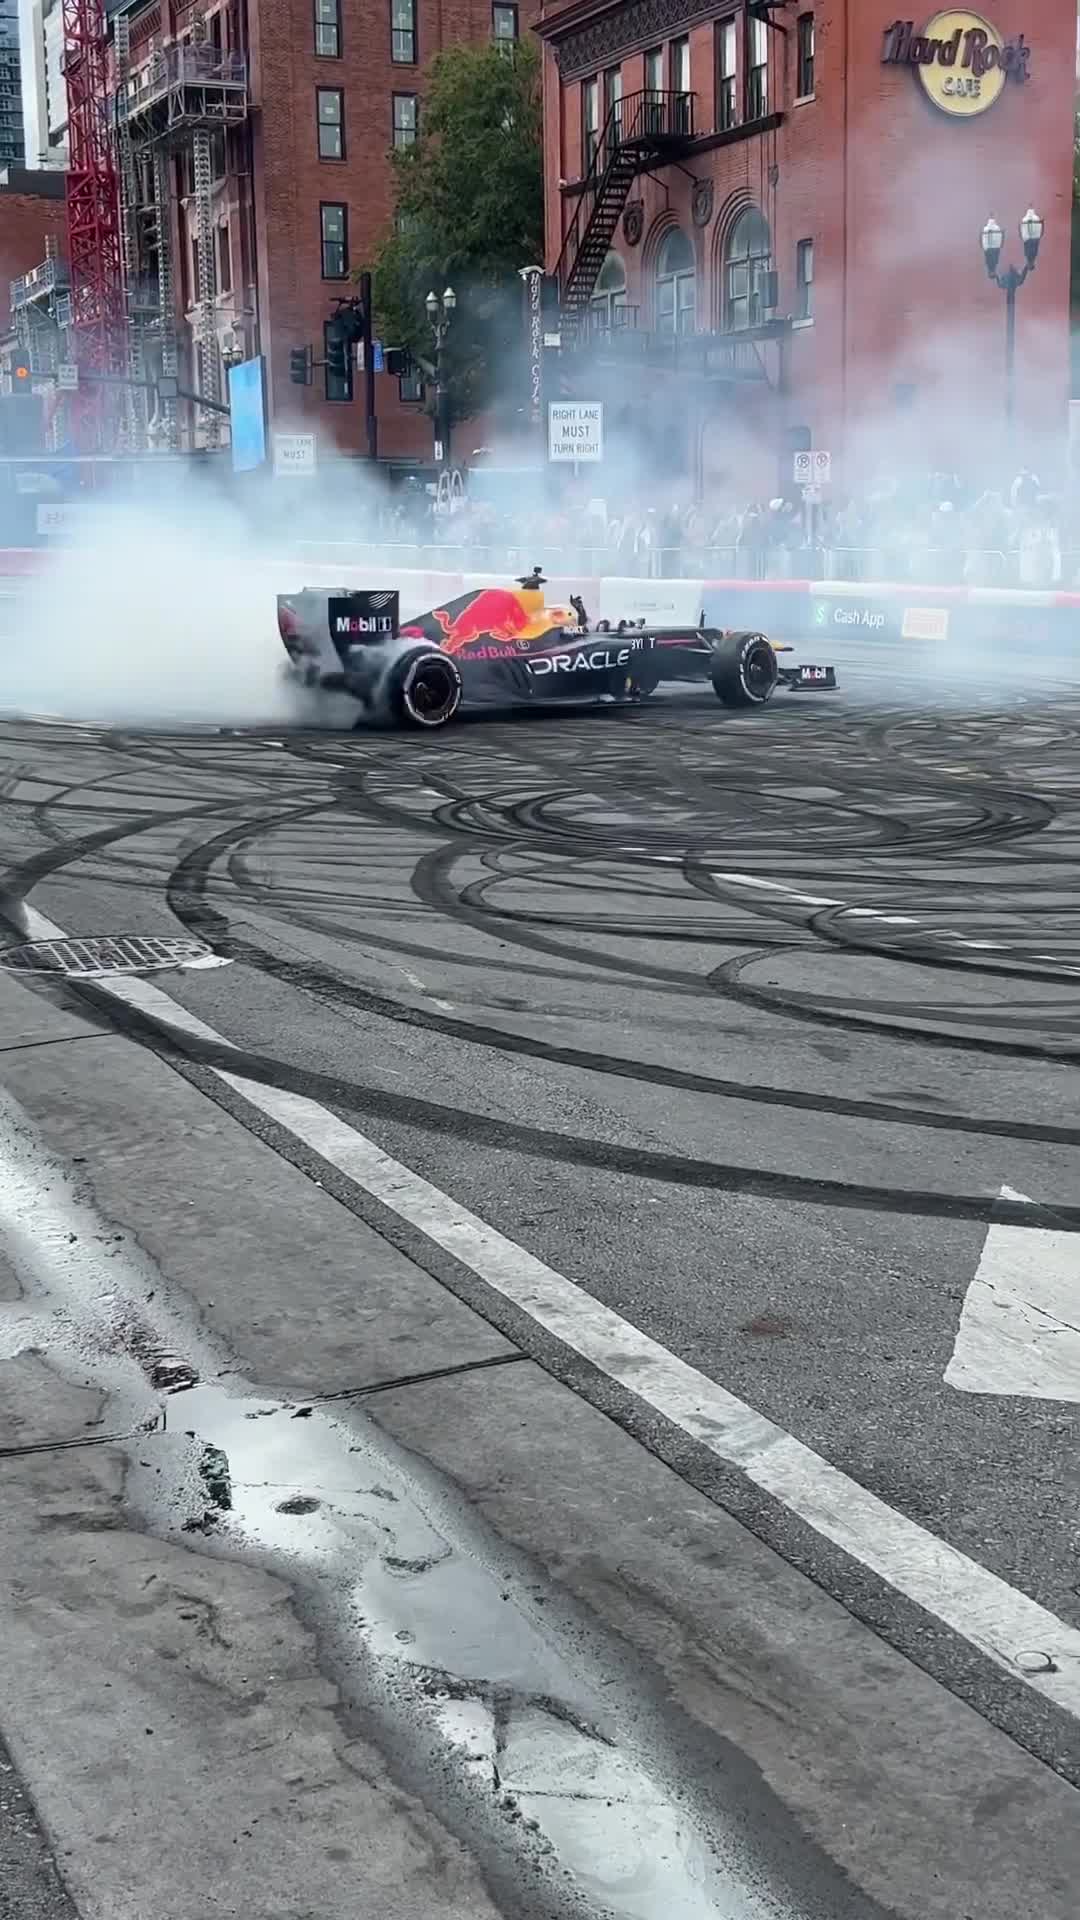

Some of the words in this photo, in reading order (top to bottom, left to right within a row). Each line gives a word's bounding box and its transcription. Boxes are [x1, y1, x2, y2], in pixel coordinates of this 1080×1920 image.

[881, 20, 963, 66] Hard
[960, 27, 1031, 80] Rock
[942, 77, 981, 98] CAFE
[530, 273, 540, 310] Hard
[531, 316, 540, 359] Rock
[552, 409, 576, 420] RIGHT
[579, 409, 599, 420] LANE
[562, 425, 589, 438] MUST
[554, 443, 574, 453] TURN
[576, 443, 599, 453] RIGHT
[336, 616, 377, 632] Mobil
[834, 608, 859, 625] Cash
[861, 608, 885, 629] App
[487, 645, 517, 659] Bull
[526, 648, 630, 675] ORACLE
[802, 667, 827, 680] Mobil
